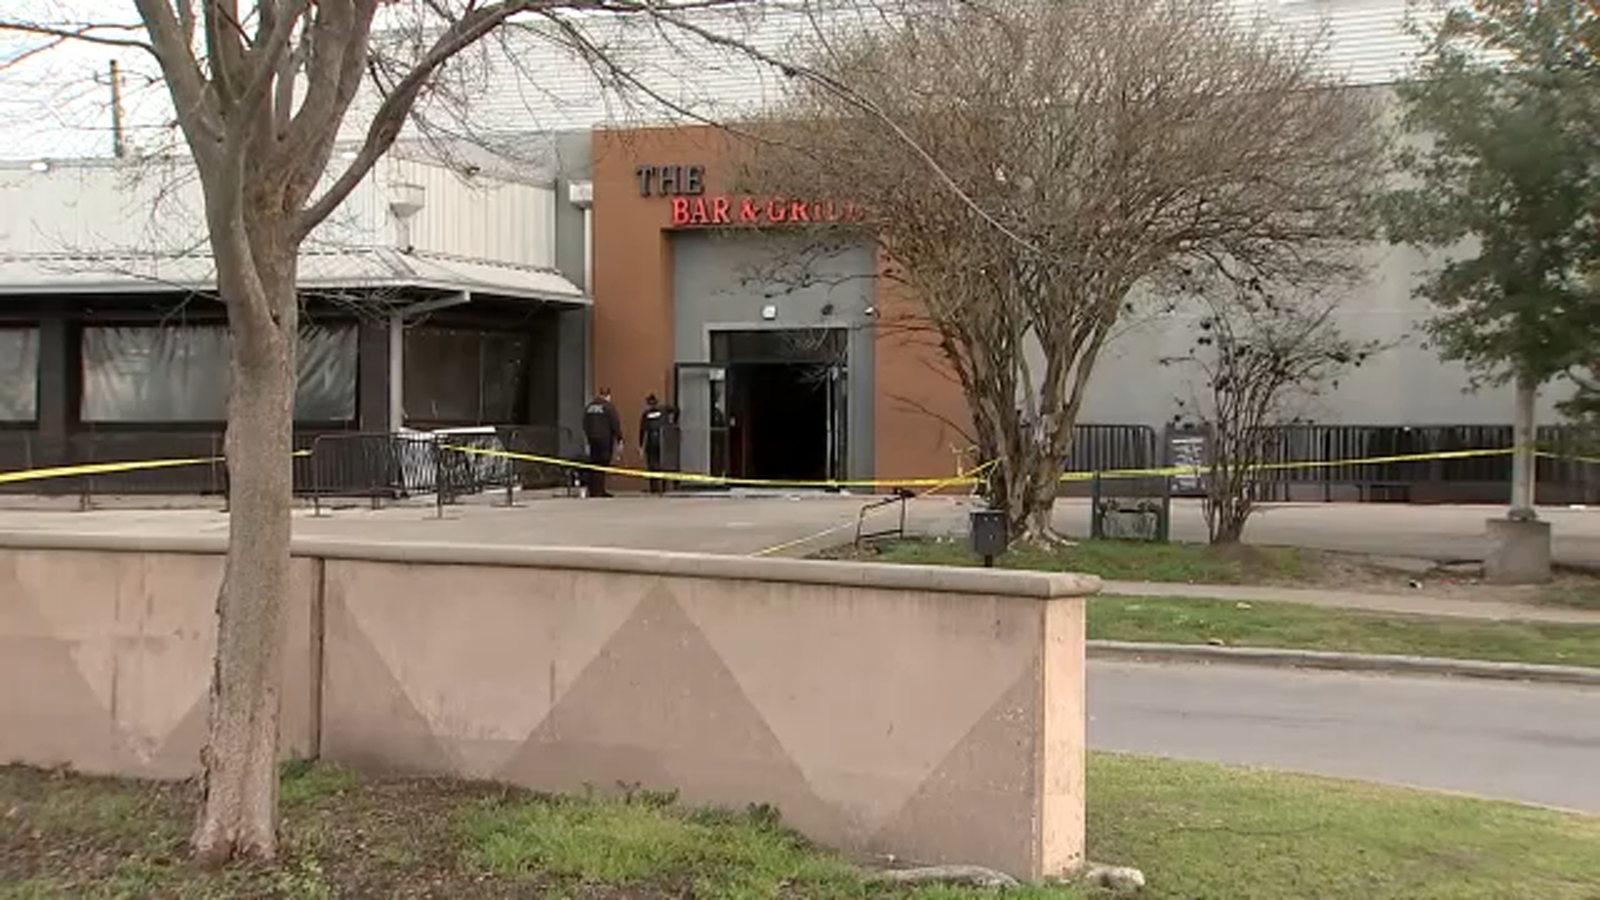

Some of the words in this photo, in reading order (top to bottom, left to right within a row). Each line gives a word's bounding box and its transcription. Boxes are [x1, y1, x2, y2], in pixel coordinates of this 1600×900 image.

[636, 165, 705, 198] THE
[671, 196, 732, 226] BAR
[739, 198, 762, 224] &
